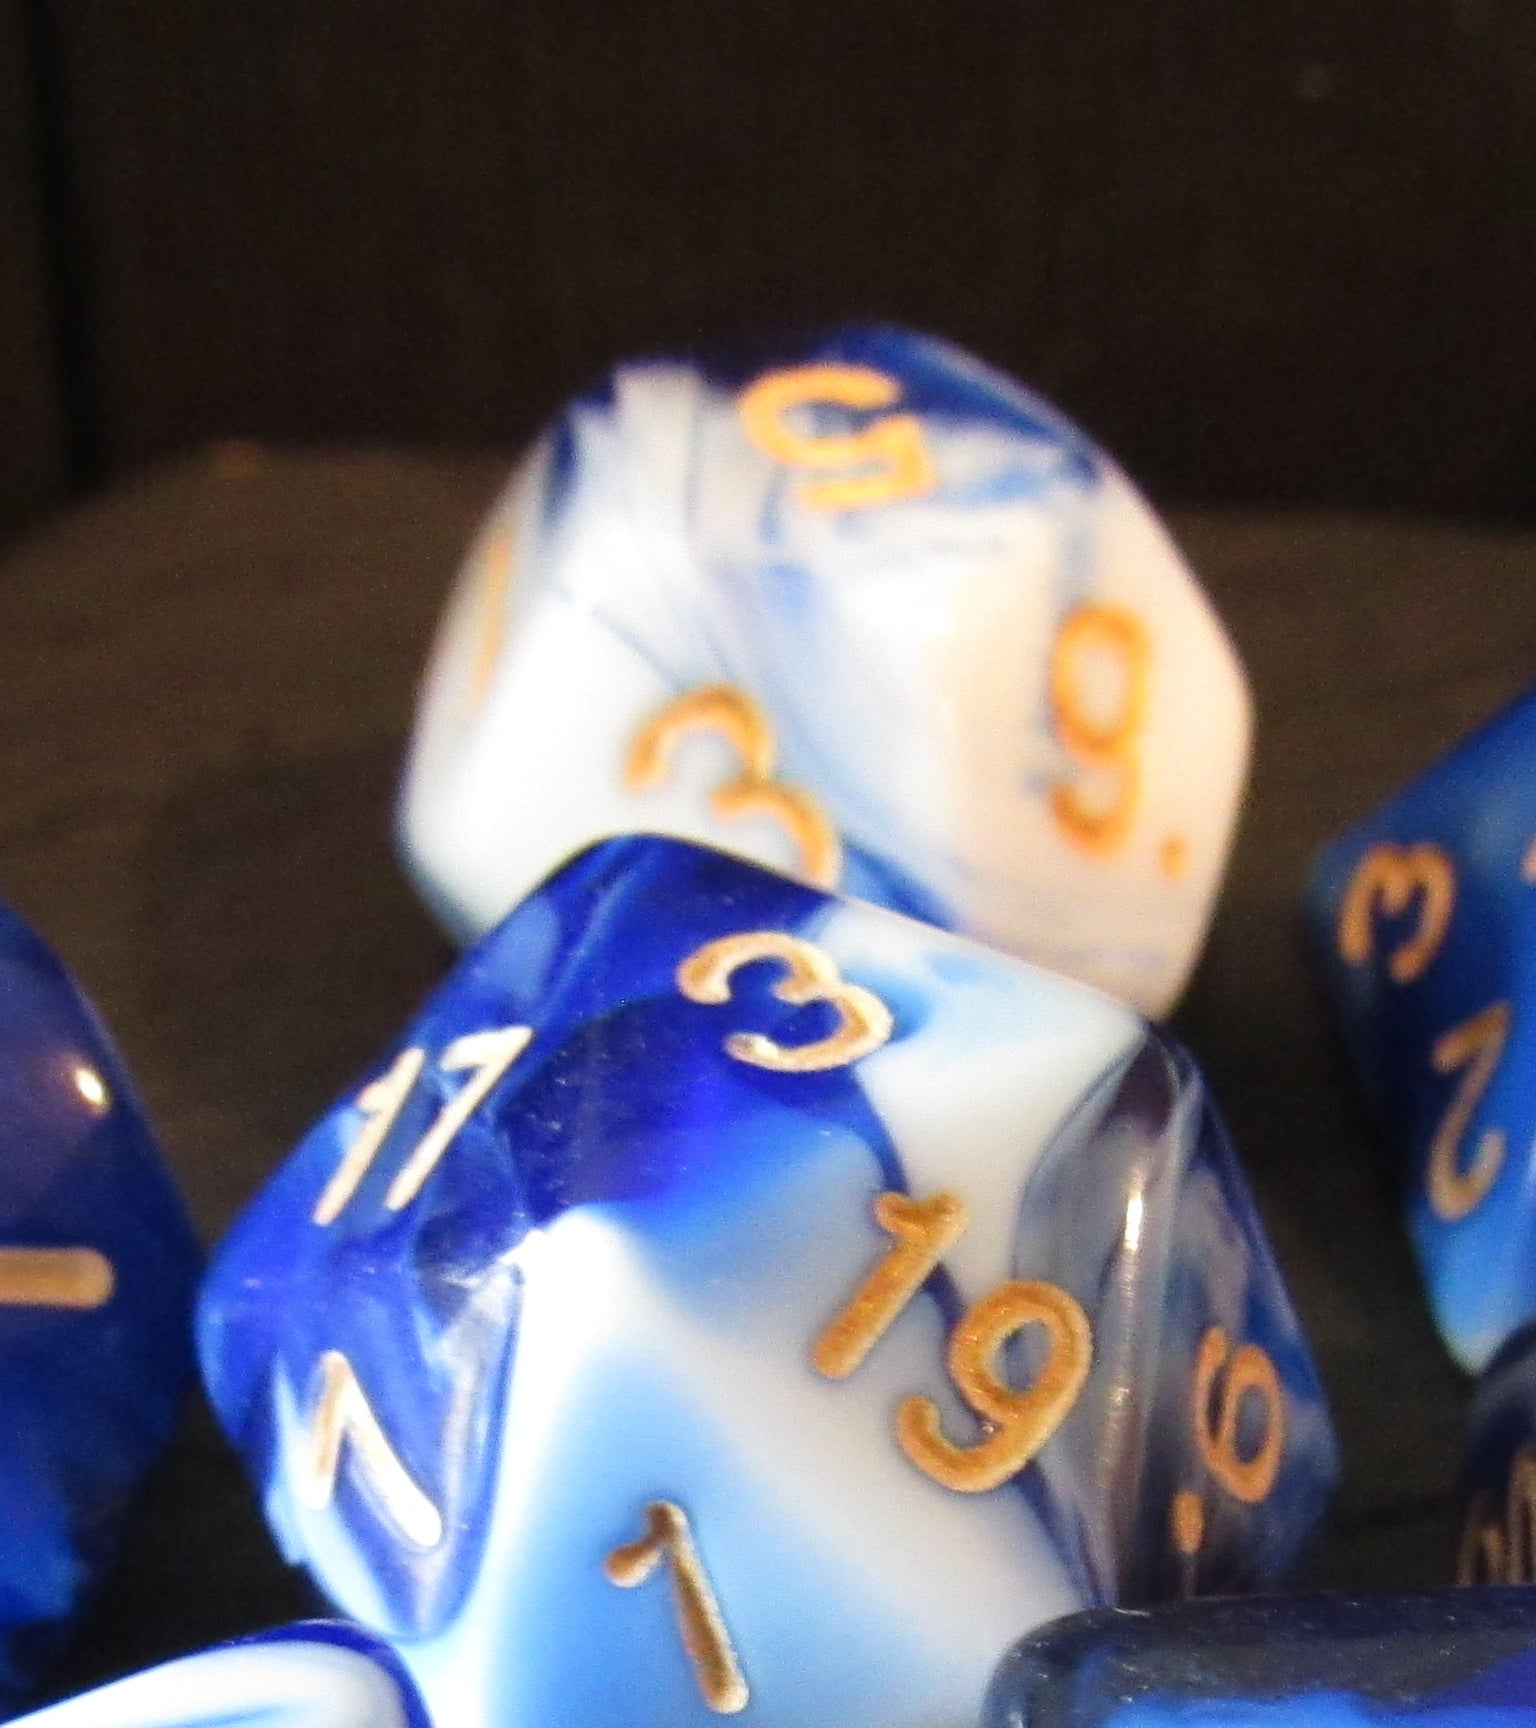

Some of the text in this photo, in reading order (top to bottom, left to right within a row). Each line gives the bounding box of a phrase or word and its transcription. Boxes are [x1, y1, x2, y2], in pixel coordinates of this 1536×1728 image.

[738, 362, 938, 513] 5
[624, 683, 839, 890] 3
[676, 931, 892, 1072] 3
[1338, 842, 1456, 986] 3
[1429, 1000, 1511, 1223] 2
[813, 1192, 1092, 1494] 19
[309, 1350, 443, 1548] 7
[604, 1500, 749, 1712] 1
